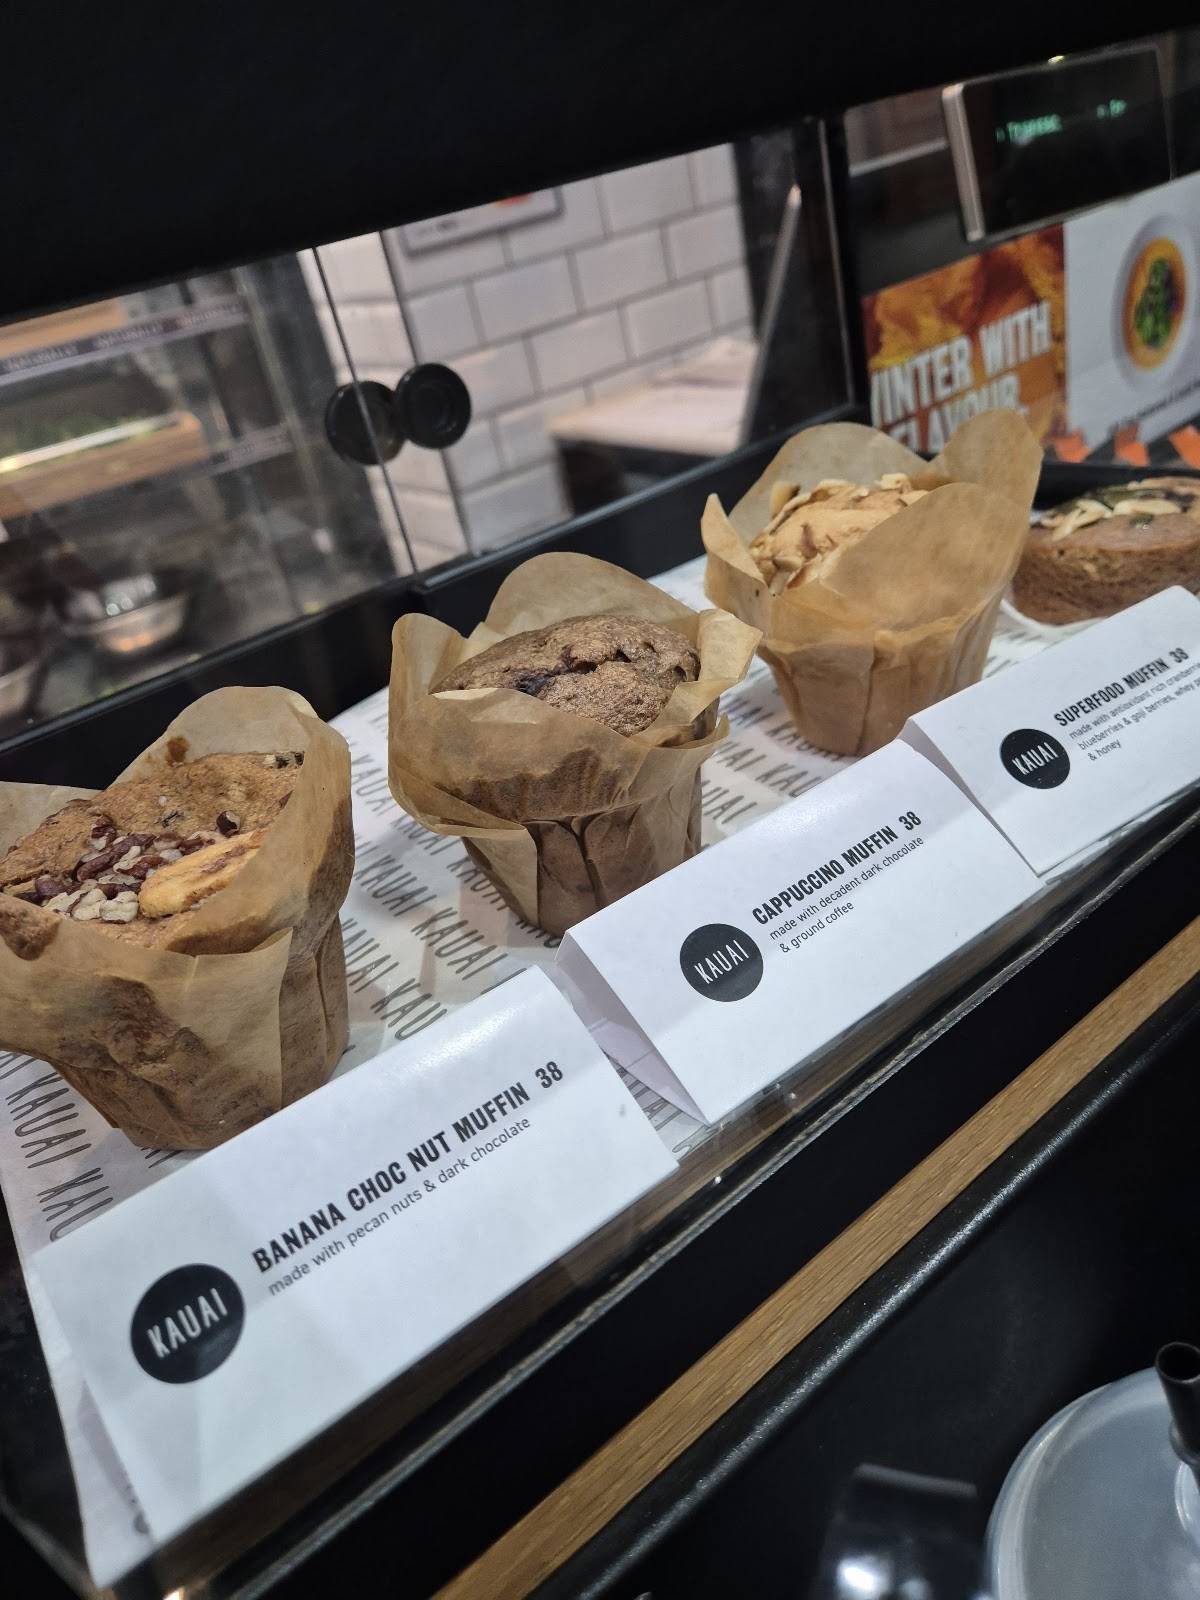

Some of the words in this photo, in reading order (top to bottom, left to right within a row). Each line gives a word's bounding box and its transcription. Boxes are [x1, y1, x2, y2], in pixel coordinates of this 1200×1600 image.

[980, 300, 1051, 378] WITH
[1054, 682, 1126, 727] SUPERFOOD
[1122, 657, 1170, 690] MUFFIN
[1168, 647, 1189, 664] 38
[1069, 723, 1093, 740] made
[1092, 712, 1111, 727] with
[1109, 691, 1151, 717] antioxidant
[1150, 681, 1167, 695] rich
[1012, 741, 1060, 776] KAUAI
[1078, 722, 1125, 751] blueberries
[1122, 716, 1132, 726] &
[1087, 752, 1098, 761] &
[1098, 738, 1122, 756] honey
[752, 859, 845, 924] CAPPUCCINO
[841, 825, 899, 867] MUFFIN
[898, 810, 922, 831] 38
[769, 917, 798, 941] made
[797, 903, 820, 922] with
[819, 877, 861, 908] decadent
[861, 863, 883, 881] dark
[882, 836, 924, 867] chocolate
[354, 854, 438, 918] KAUAI
[411, 906, 509, 981] KAUAI
[780, 942, 792, 953] &
[791, 920, 826, 950] ground
[825, 901, 855, 925] coffee
[694, 939, 750, 984] KAUAI
[6, 1072, 92, 1169] KAUAI
[252, 1202, 346, 1273] BANANA
[346, 1161, 407, 1212] CHOC
[406, 1131, 452, 1172] NUT
[451, 1081, 531, 1144] MUFFIN
[535, 1060, 564, 1090] 38
[268, 1260, 311, 1297] made
[312, 1238, 346, 1267] with
[347, 1209, 390, 1249] pecan
[391, 1187, 423, 1218] nuts
[423, 1178, 437, 1193] &
[437, 1157, 470, 1185] dark
[470, 1117, 531, 1164] chocolate
[147, 1287, 229, 1359] KAUAI
